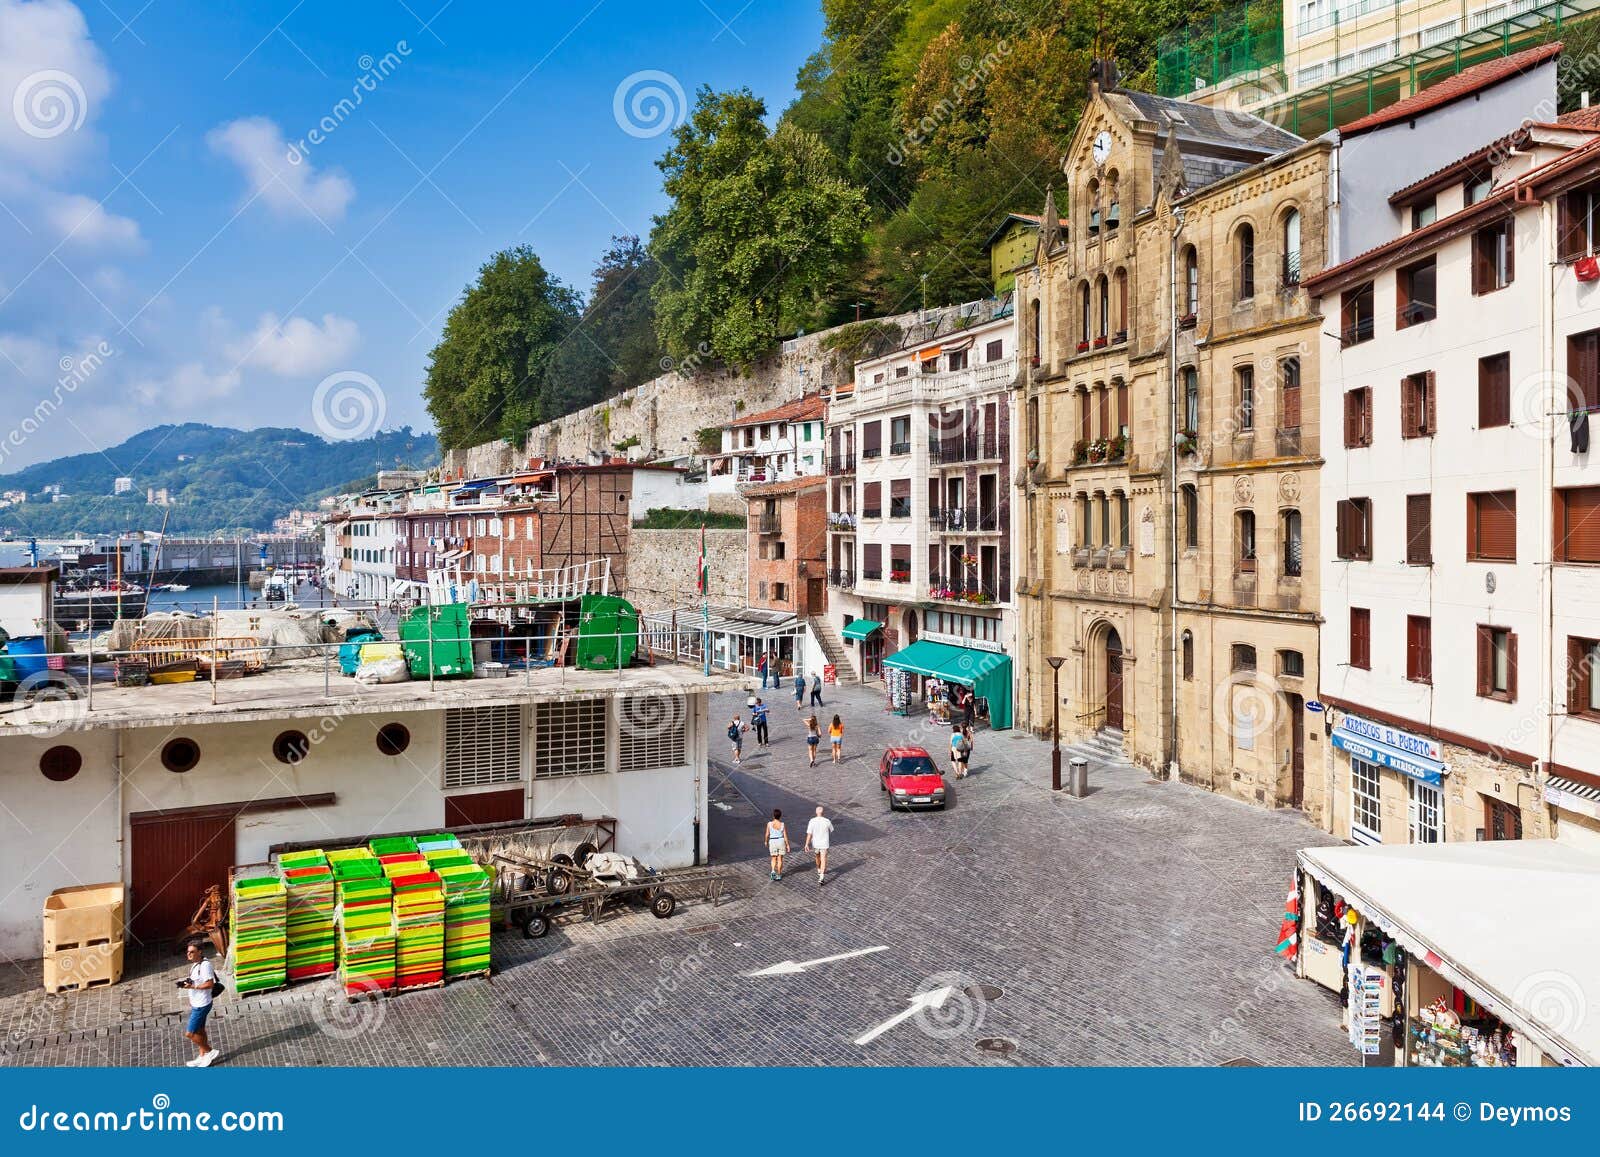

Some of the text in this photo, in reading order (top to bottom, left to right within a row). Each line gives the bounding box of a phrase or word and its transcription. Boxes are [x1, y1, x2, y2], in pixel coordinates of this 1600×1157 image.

[1345, 716, 1430, 757] MARISCOS EL PUERTO
[1343, 741, 1425, 778] COCEDERO DE MARISCOS
